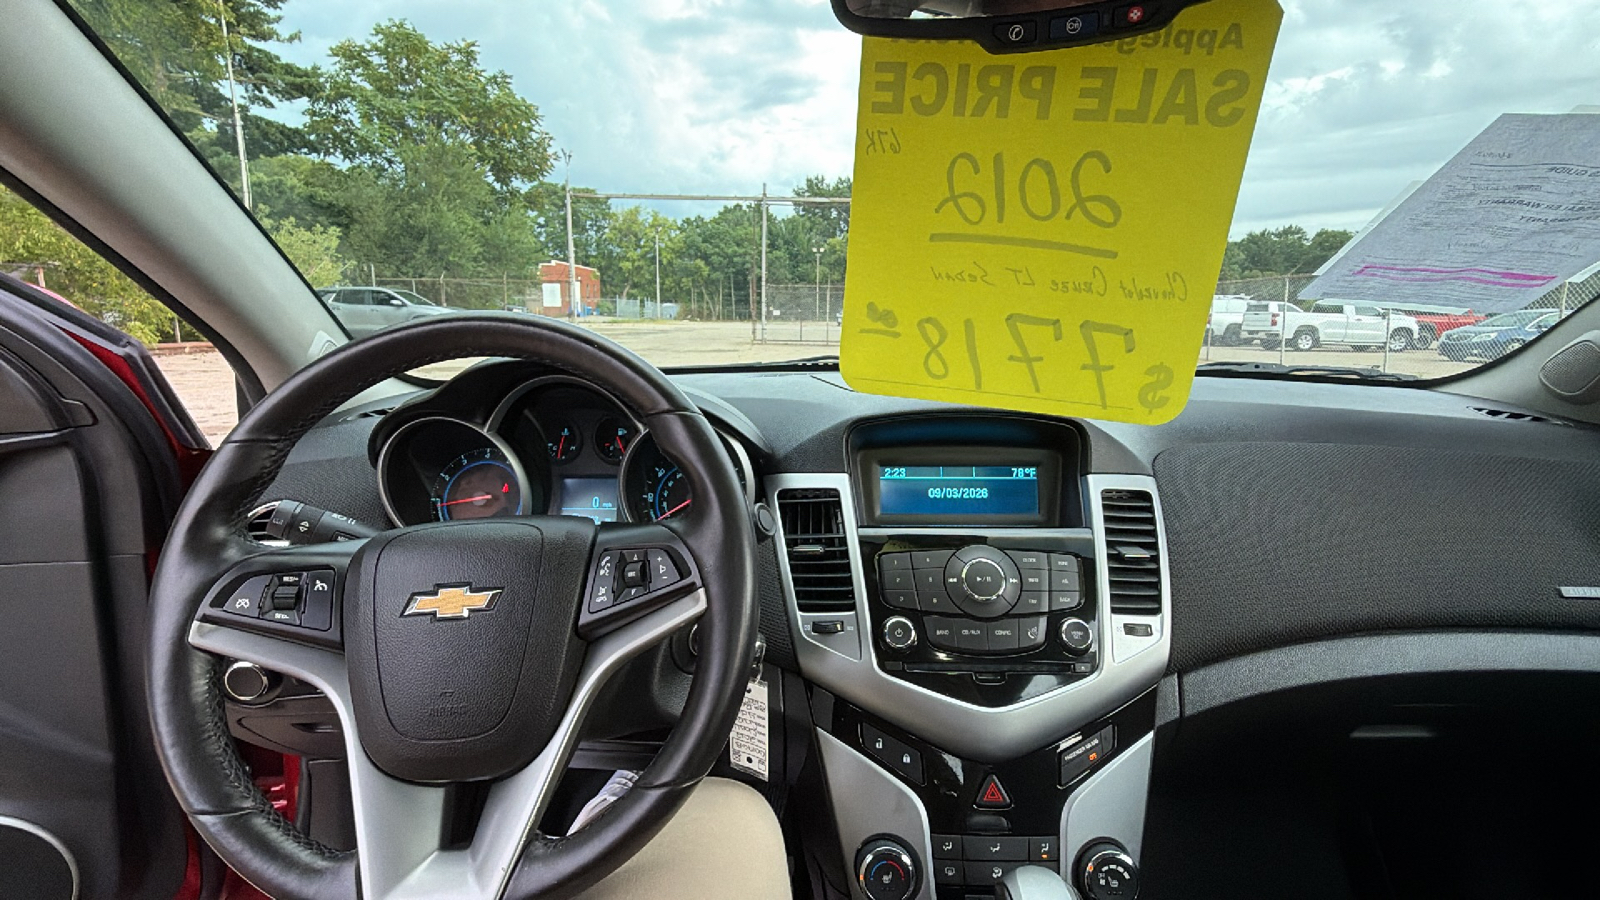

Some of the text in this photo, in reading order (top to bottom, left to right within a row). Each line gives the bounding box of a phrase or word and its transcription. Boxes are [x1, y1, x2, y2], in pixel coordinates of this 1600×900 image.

[884, 467, 1036, 478] 2:23 78°F
[928, 487, 989, 499] 09/03/2026
[592, 496, 600, 508] 0
